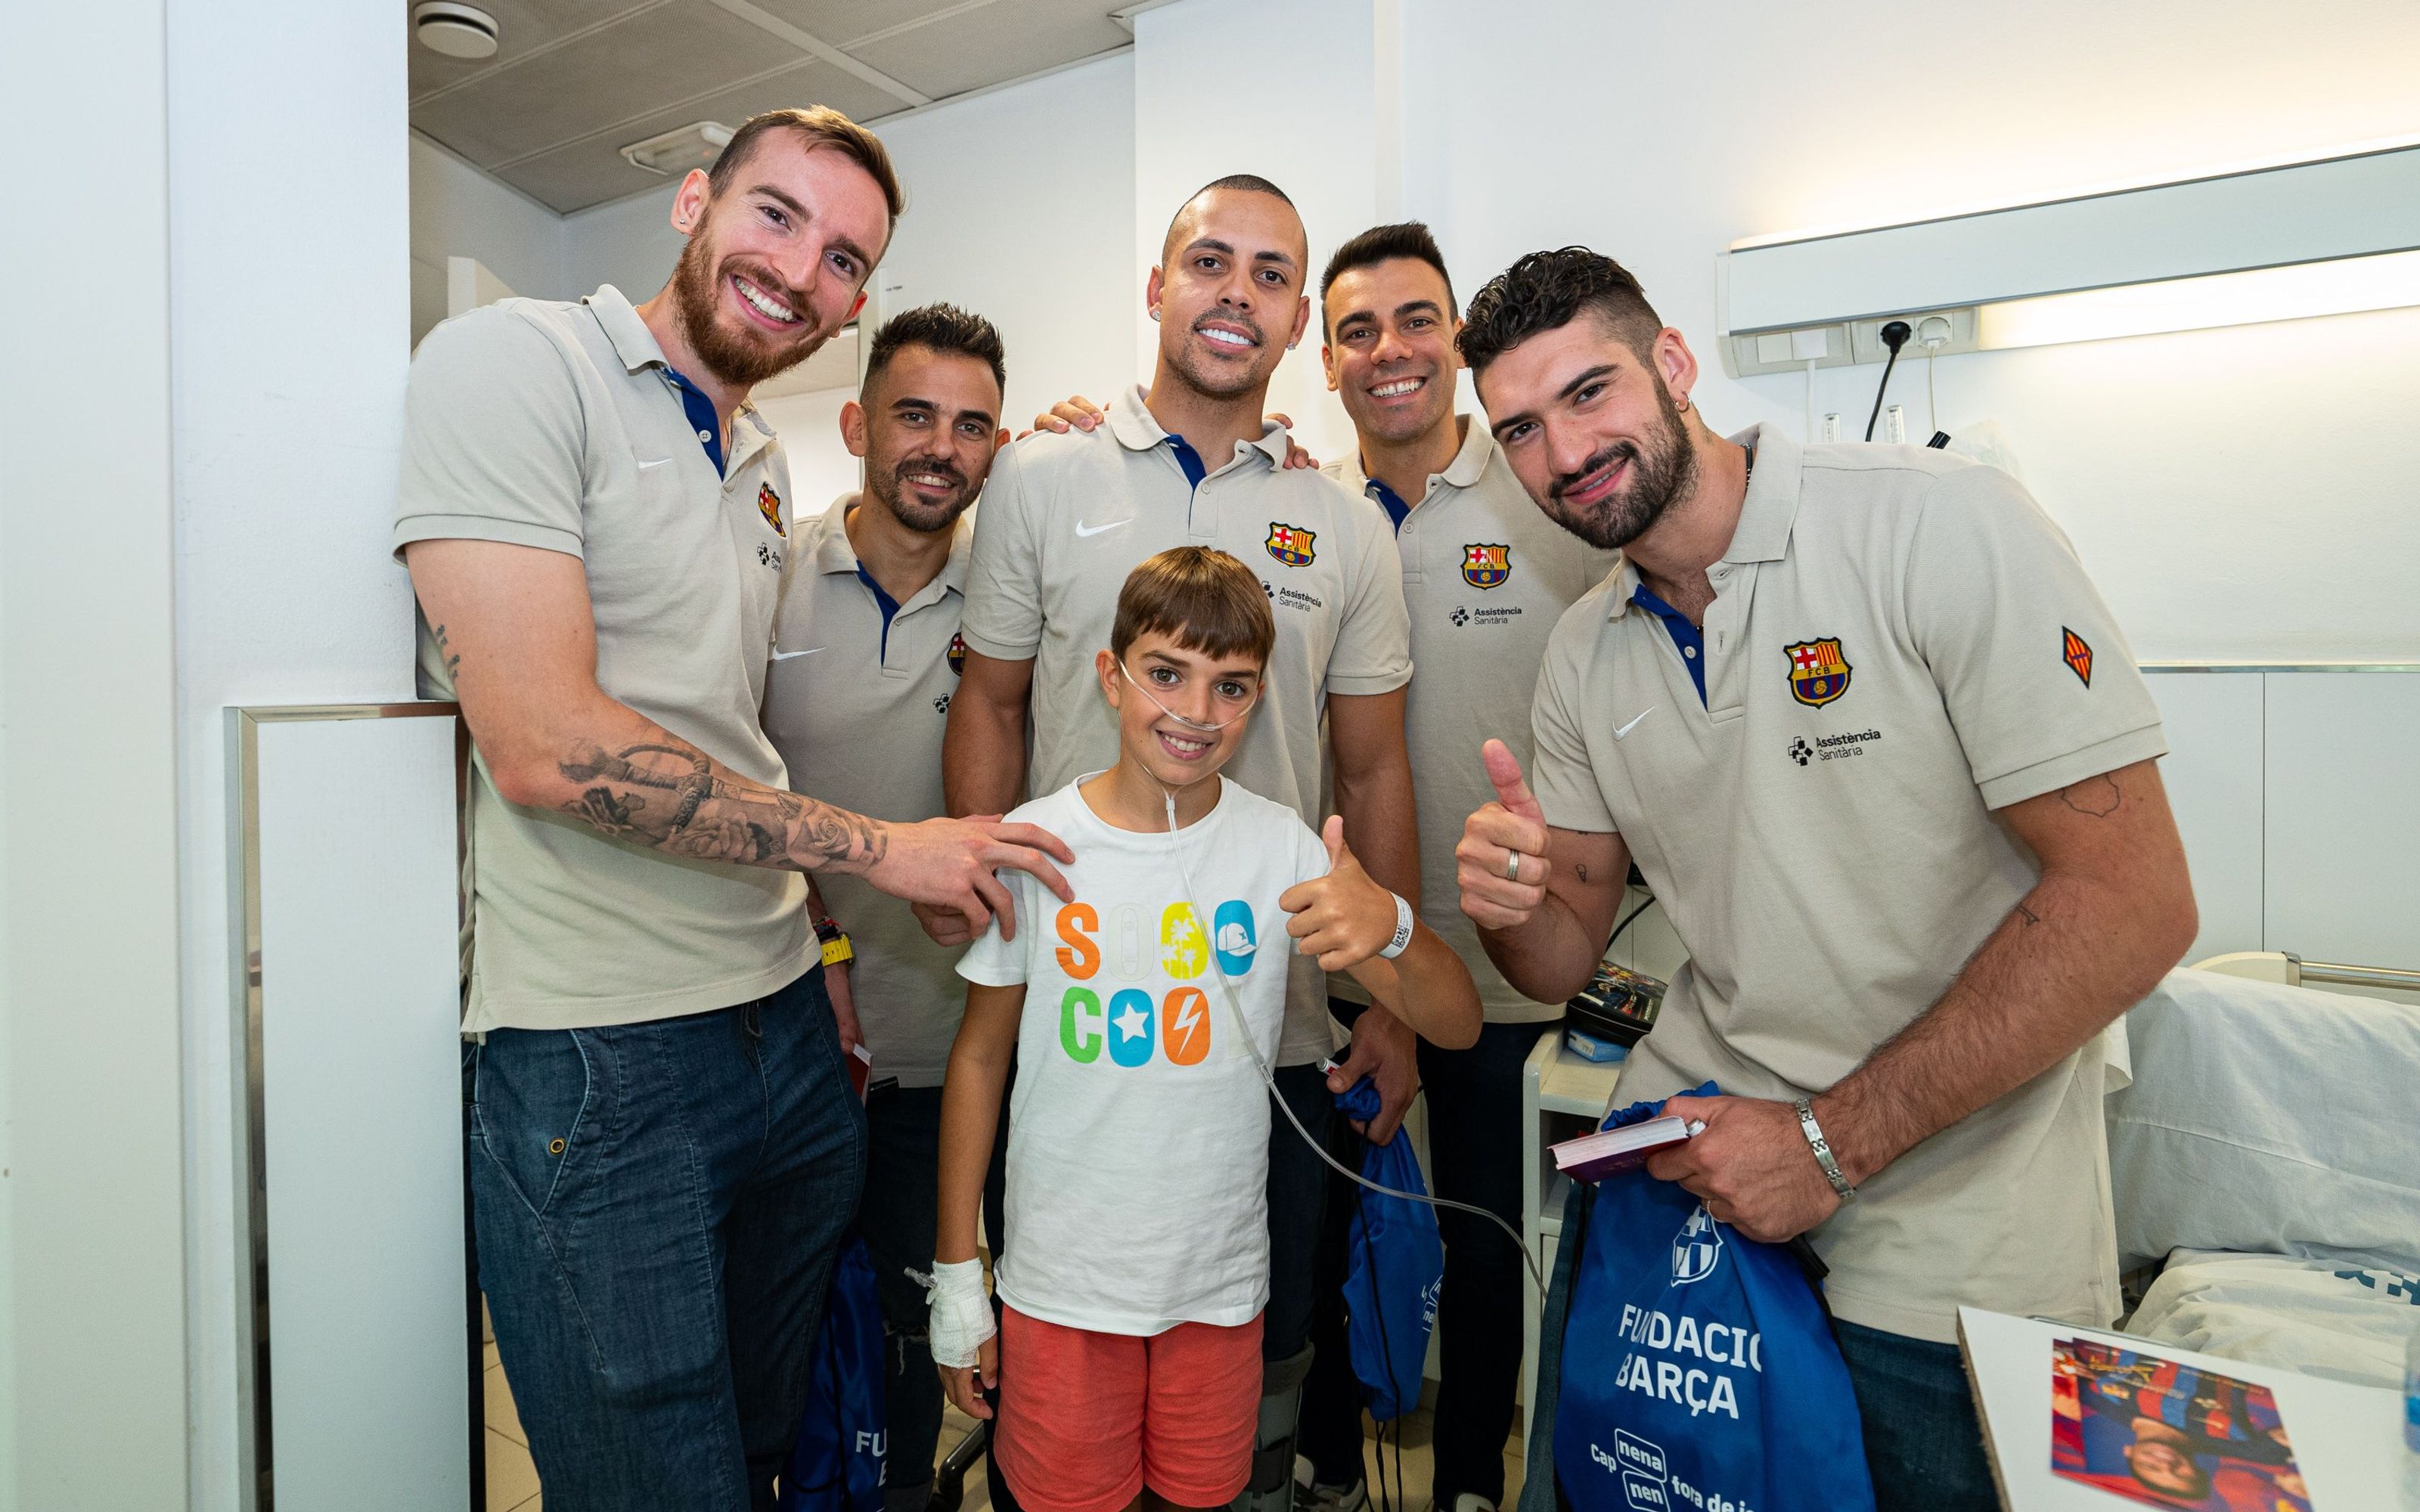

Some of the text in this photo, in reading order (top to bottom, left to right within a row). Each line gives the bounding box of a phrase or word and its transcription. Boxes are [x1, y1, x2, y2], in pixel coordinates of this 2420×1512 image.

[1281, 544, 1299, 552] FCB
[1279, 587, 1322, 608] Assistència
[1474, 606, 1522, 616] Assistència
[1808, 667, 1831, 677] FCB
[1816, 729, 1882, 748] Assistència
[1818, 745, 1863, 761] Sanitària
[1615, 1352, 1739, 1420] BARÇA
[1618, 1439, 1663, 1473] nena
[1590, 1443, 1617, 1473] Cap
[1671, 1475, 1703, 1509] fora
[1630, 1482, 1664, 1505] nen
